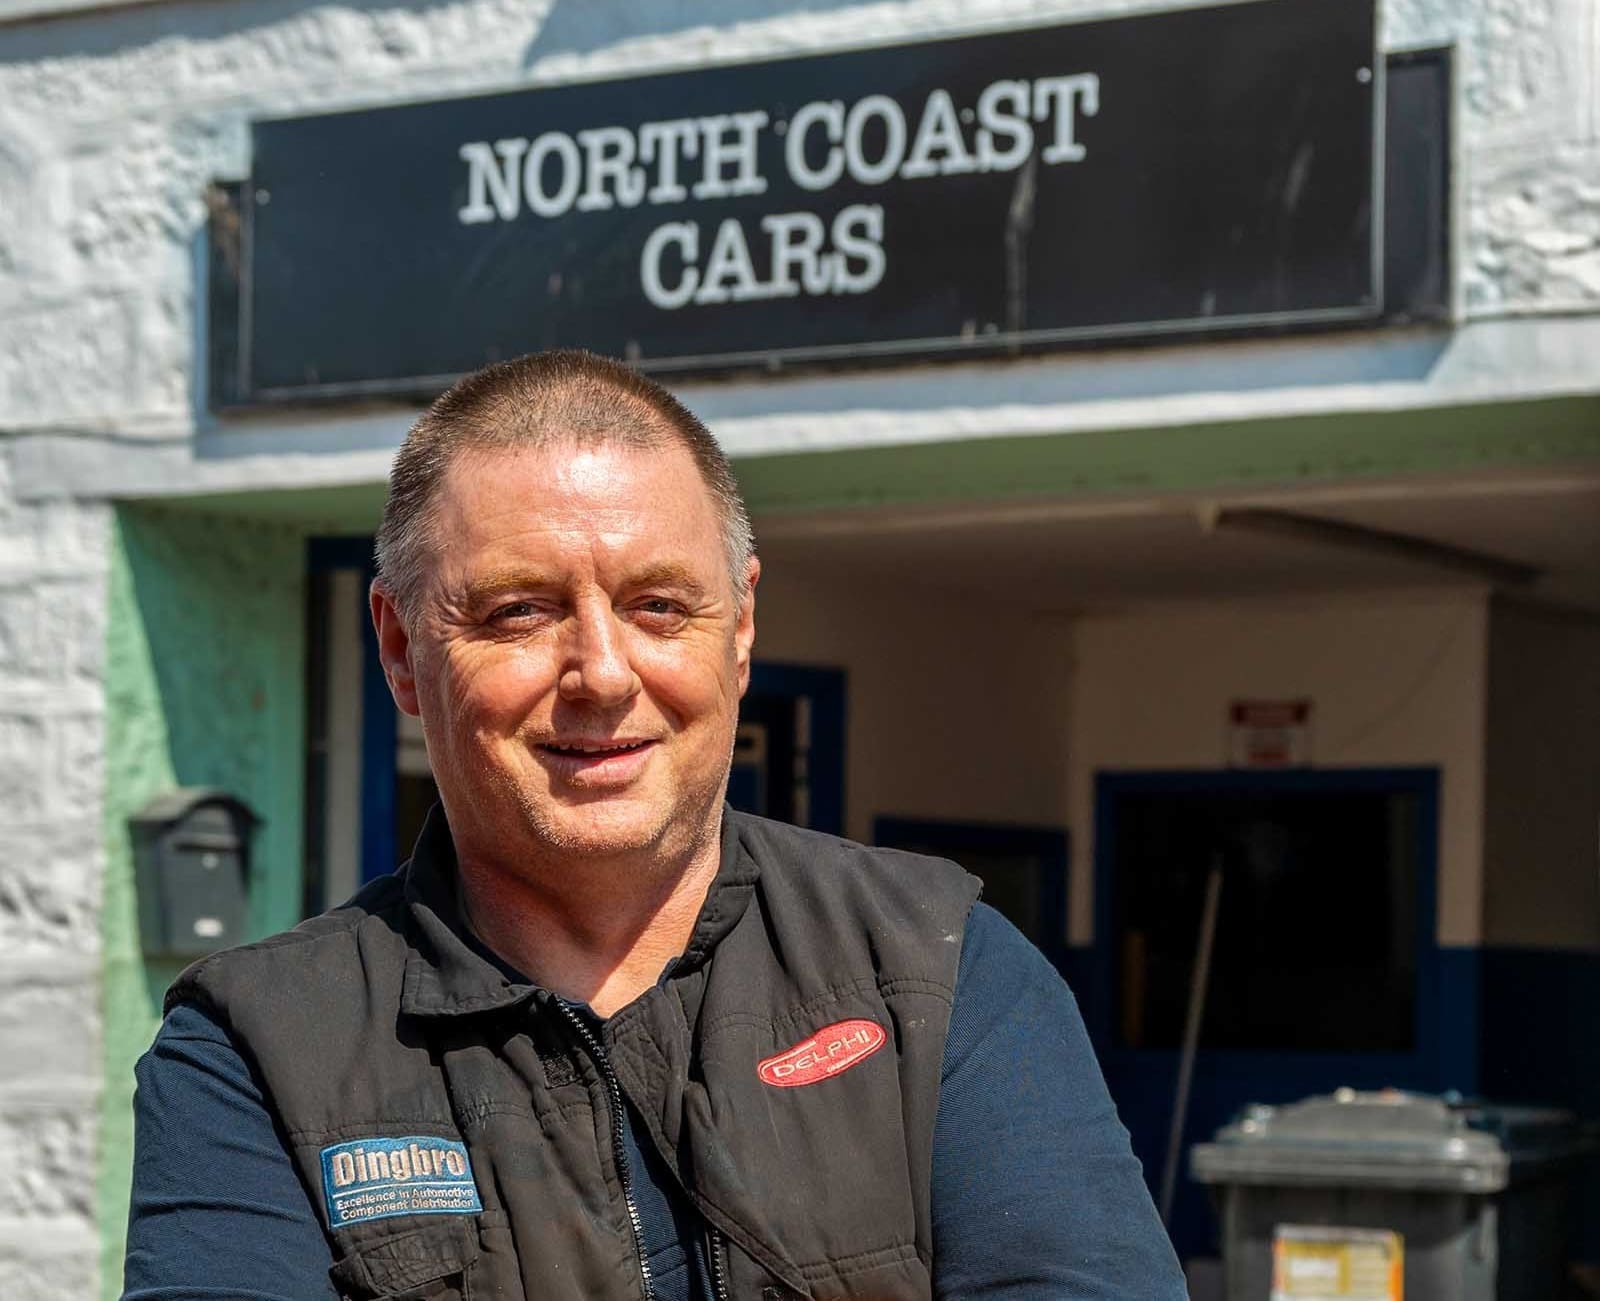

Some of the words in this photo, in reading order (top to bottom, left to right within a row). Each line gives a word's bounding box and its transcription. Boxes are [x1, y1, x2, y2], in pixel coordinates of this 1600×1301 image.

[458, 110, 768, 225] NORTH
[784, 73, 1100, 190] COAST
[640, 204, 886, 309] CARS
[773, 1030, 871, 1078] DELPHI
[332, 1143, 467, 1187] Dingbro
[337, 1190, 396, 1211] Excellence
[400, 1189, 410, 1199] in
[413, 1188, 474, 1199] Automotive
[341, 1201, 408, 1221] Component
[412, 1198, 474, 1209] Distribution
